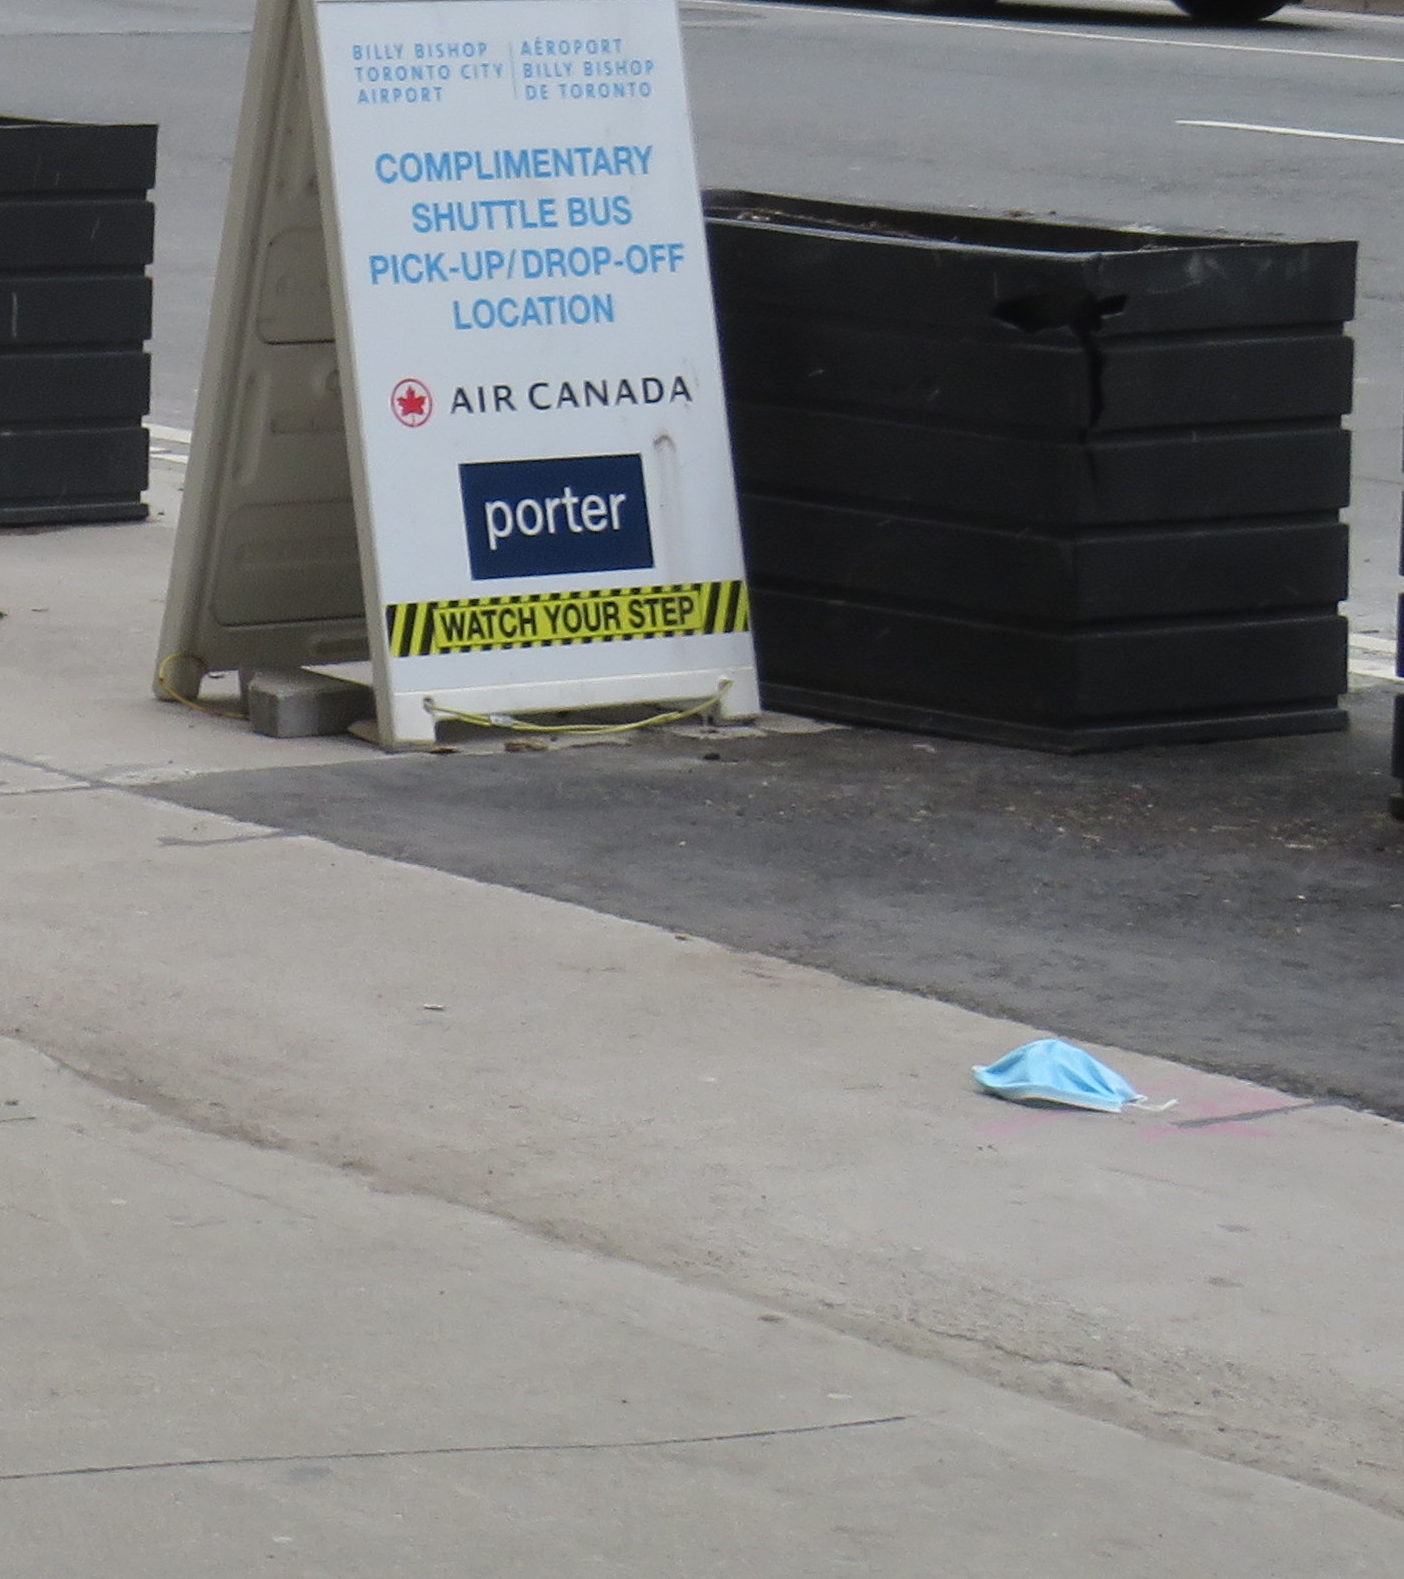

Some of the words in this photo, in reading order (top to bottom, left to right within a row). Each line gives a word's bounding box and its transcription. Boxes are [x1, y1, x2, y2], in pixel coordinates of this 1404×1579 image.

[353, 44, 404, 61] BILLY
[414, 42, 487, 59] BISHOP
[520, 37, 622, 56] AÉROPORT
[355, 65, 450, 82] TORONTO
[460, 63, 503, 80] CITY
[523, 62, 573, 78] BILLY
[584, 60, 655, 77] BISHOP
[357, 86, 443, 104] AIRPORT
[525, 84, 549, 100] DE
[559, 81, 652, 99] TORONTO
[375, 145, 654, 184] COMPLIMENTARY
[411, 198, 558, 233] SHUTTLE
[566, 196, 634, 228] BUS
[369, 243, 686, 286] PICK-UP/DROP-OFF
[452, 294, 616, 331] LOCATION
[450, 383, 517, 414] AIR
[528, 375, 693, 411] CANADA
[484, 486, 627, 551] porter
[440, 607, 541, 643] WATCH
[543, 601, 621, 635] YOUR
[630, 596, 695, 630] STEP
